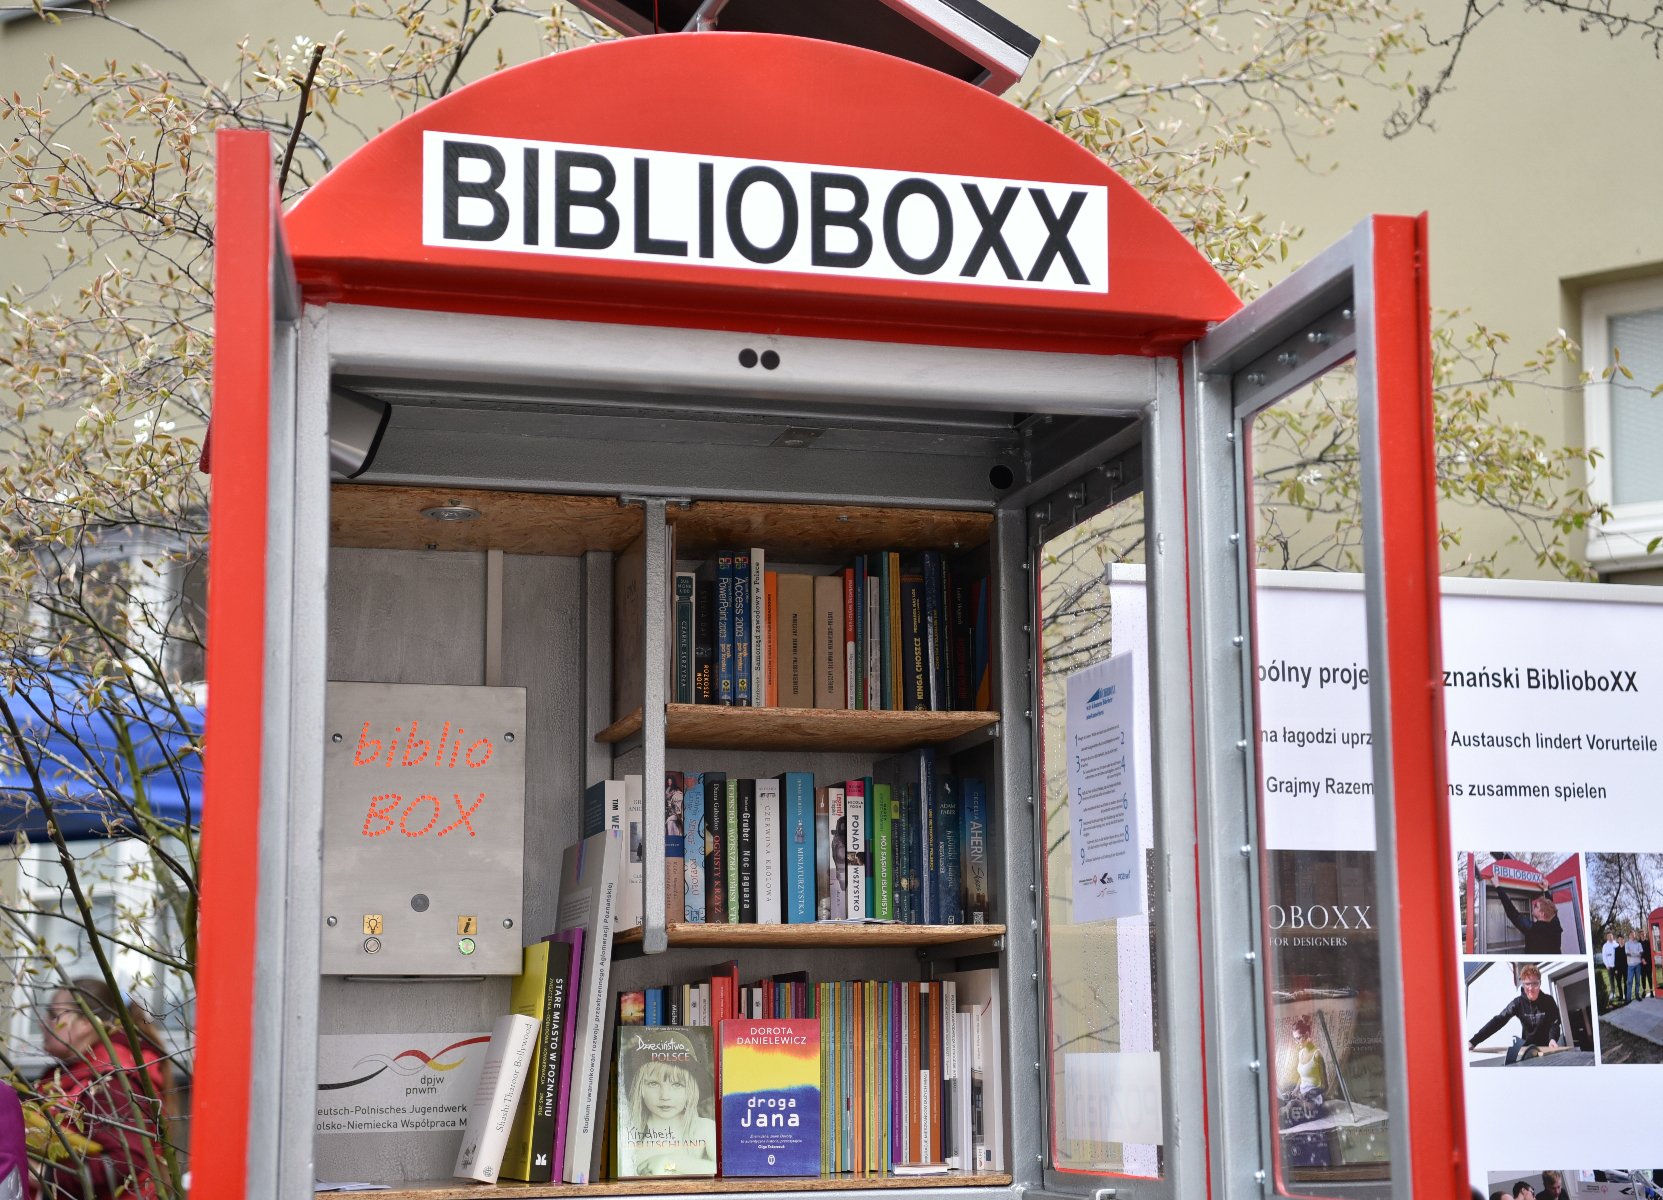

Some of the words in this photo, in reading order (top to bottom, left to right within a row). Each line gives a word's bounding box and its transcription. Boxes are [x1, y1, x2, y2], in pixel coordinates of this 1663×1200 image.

[443, 140, 1091, 286] BIBLIOBOXX
[719, 577, 729, 621] PowerPoint
[735, 577, 745, 614] Access
[736, 616, 744, 637] 2003
[914, 638, 922, 673] CHOSZCZ
[1258, 660, 1312, 689] pólny
[1319, 663, 1370, 690] proje
[1442, 667, 1520, 689] znański
[1527, 668, 1638, 693] BiblioboXX
[353, 720, 493, 768] biblio
[1075, 733, 1078, 747] 1
[1120, 731, 1125, 745] 2
[1260, 730, 1278, 743] na
[1283, 727, 1337, 748] łagodzi
[1341, 732, 1373, 749] uprz
[1451, 731, 1531, 748] Austausch
[1536, 733, 1582, 750] lindert
[1586, 734, 1658, 751] Vorurteile
[1076, 755, 1081, 774] 3
[1121, 755, 1126, 773] 4
[1077, 787, 1083, 805] 5
[1266, 776, 1320, 798] Grajmy
[1325, 778, 1375, 795] Razem
[1447, 783, 1463, 796] ns
[1468, 784, 1550, 797] zusammen
[1554, 782, 1607, 802] spielen
[362, 792, 486, 838] BOX
[612, 815, 620, 830] WE
[1078, 818, 1083, 836] 7
[851, 815, 859, 850] PONAD
[970, 821, 983, 863] AHERN
[1125, 824, 1129, 842] 8
[713, 836, 721, 877] OGNISTY
[728, 829, 736, 870] PRZYSŁÓW
[1080, 848, 1085, 866] 9
[797, 847, 805, 915] MINIATURZYSTKA
[1494, 865, 1541, 882] BIBLIOBOXX
[714, 881, 722, 914] KRZYŻ
[729, 873, 737, 902] KSIĘGA
[742, 872, 750, 909] jaguara
[852, 867, 860, 912] WSZYSTKO
[603, 882, 614, 923] Poznańskiej
[1266, 904, 1372, 930] OBOXX
[599, 925, 609, 966] Aglomeracji
[1293, 937, 1348, 948] DESIGNERS
[553, 979, 563, 1008] STARE
[594, 968, 605, 1022] przestrzennego
[550, 1011, 560, 1049] MIASTO
[591, 1023, 599, 1051] rozwoju
[636, 1035, 685, 1051] Dzieciństwo
[736, 1036, 807, 1045] DANIELEWICZ
[750, 1027, 793, 1035] DOROTA
[503, 1070, 519, 1103] Tharoor
[514, 1023, 532, 1068] Bollywood
[549, 1052, 556, 1061] W
[651, 1052, 690, 1062] POLSCE
[405, 1086, 437, 1096] pnwm
[420, 1075, 445, 1086] dpjw
[544, 1063, 555, 1117] POZNANIU
[586, 1054, 596, 1102] uwarunkowań
[317, 1105, 407, 1117] eutsch-Polnisches
[409, 1103, 468, 1115] Jugendwerk
[748, 1096, 797, 1110] droga
[316, 1119, 398, 1131] olsko-Niemiecka
[400, 1118, 457, 1130] Współpraca
[459, 1118, 468, 1128] M
[583, 1104, 591, 1133] Studium
[741, 1109, 800, 1127] Jana
[626, 1126, 673, 1141] Kindheit
[628, 1139, 707, 1148] DEUTSCHLAND
